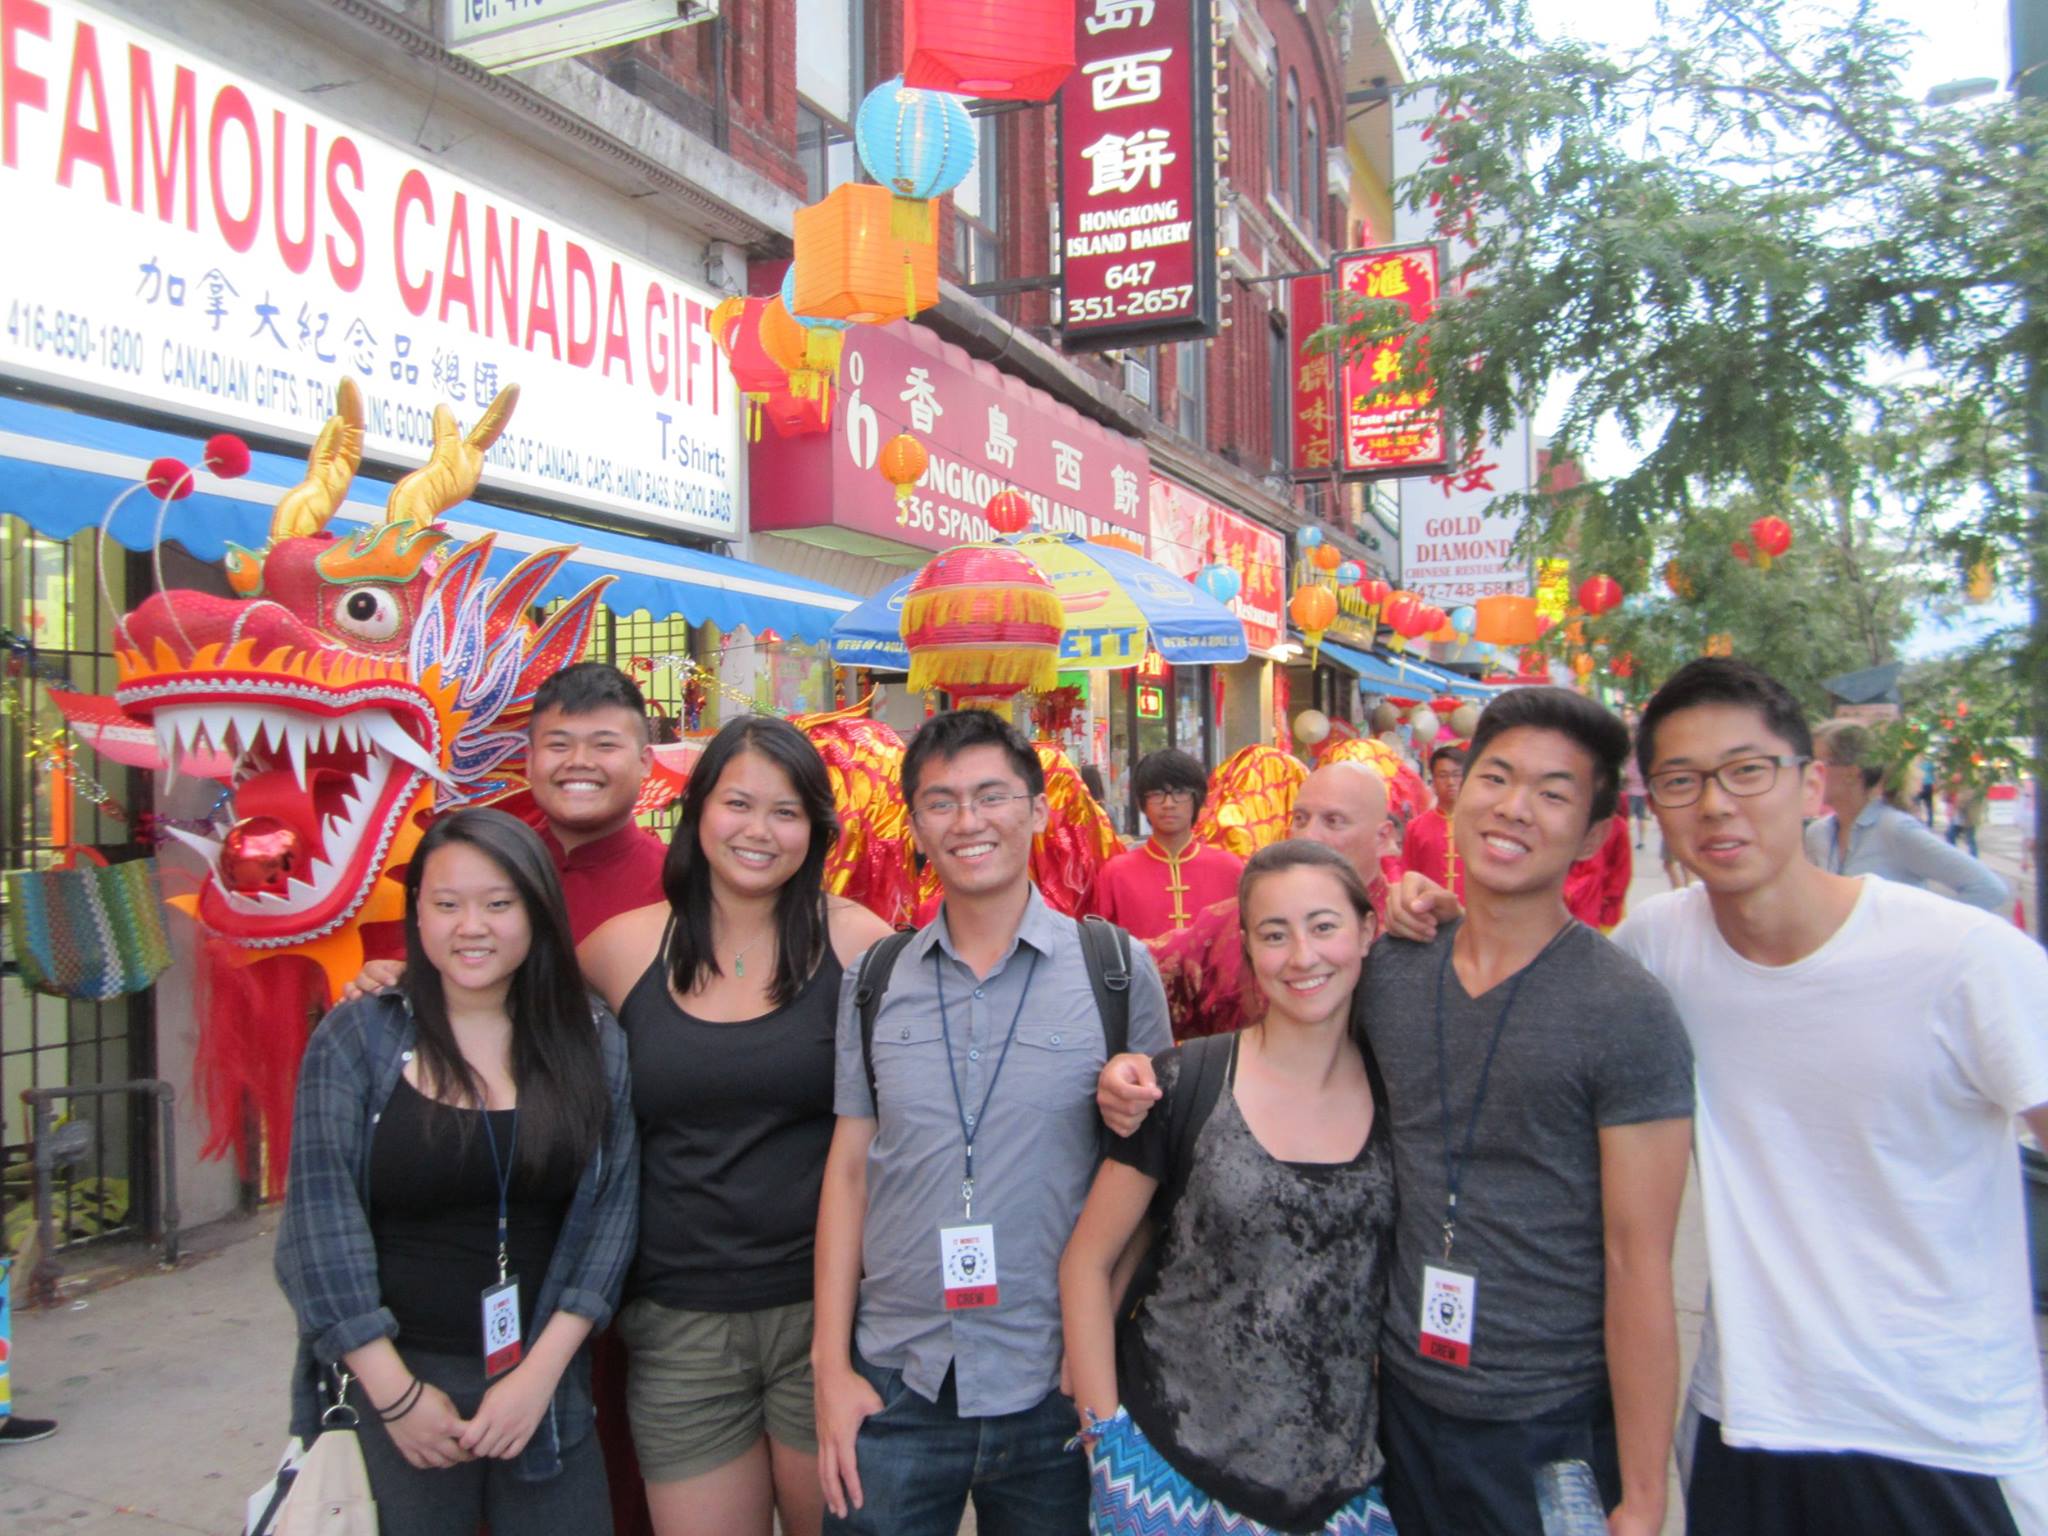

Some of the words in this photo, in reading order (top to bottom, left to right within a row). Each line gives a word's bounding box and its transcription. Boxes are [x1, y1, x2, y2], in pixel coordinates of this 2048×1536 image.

[0, 0, 365, 293] FAMOUS
[393, 168, 633, 386] CANADA
[1080, 199, 1179, 232] HONGKONG
[1066, 232, 1127, 258] ISLAND
[1130, 221, 1192, 250] BAKERY
[1104, 260, 1156, 290] 647
[1068, 284, 1194, 323] 351-2657
[7, 298, 144, 377] 416-850-1800
[161, 337, 249, 403] CANADIAN
[519, 436, 533, 474] OF
[901, 366, 1141, 518] 香島西餅
[1024, 490, 1088, 542] SLAND
[1426, 516, 1481, 538] GOLD
[1417, 539, 1513, 563] DIAMOND
[1405, 566, 1451, 579] CHINESE
[1060, 626, 1137, 658] ETT
